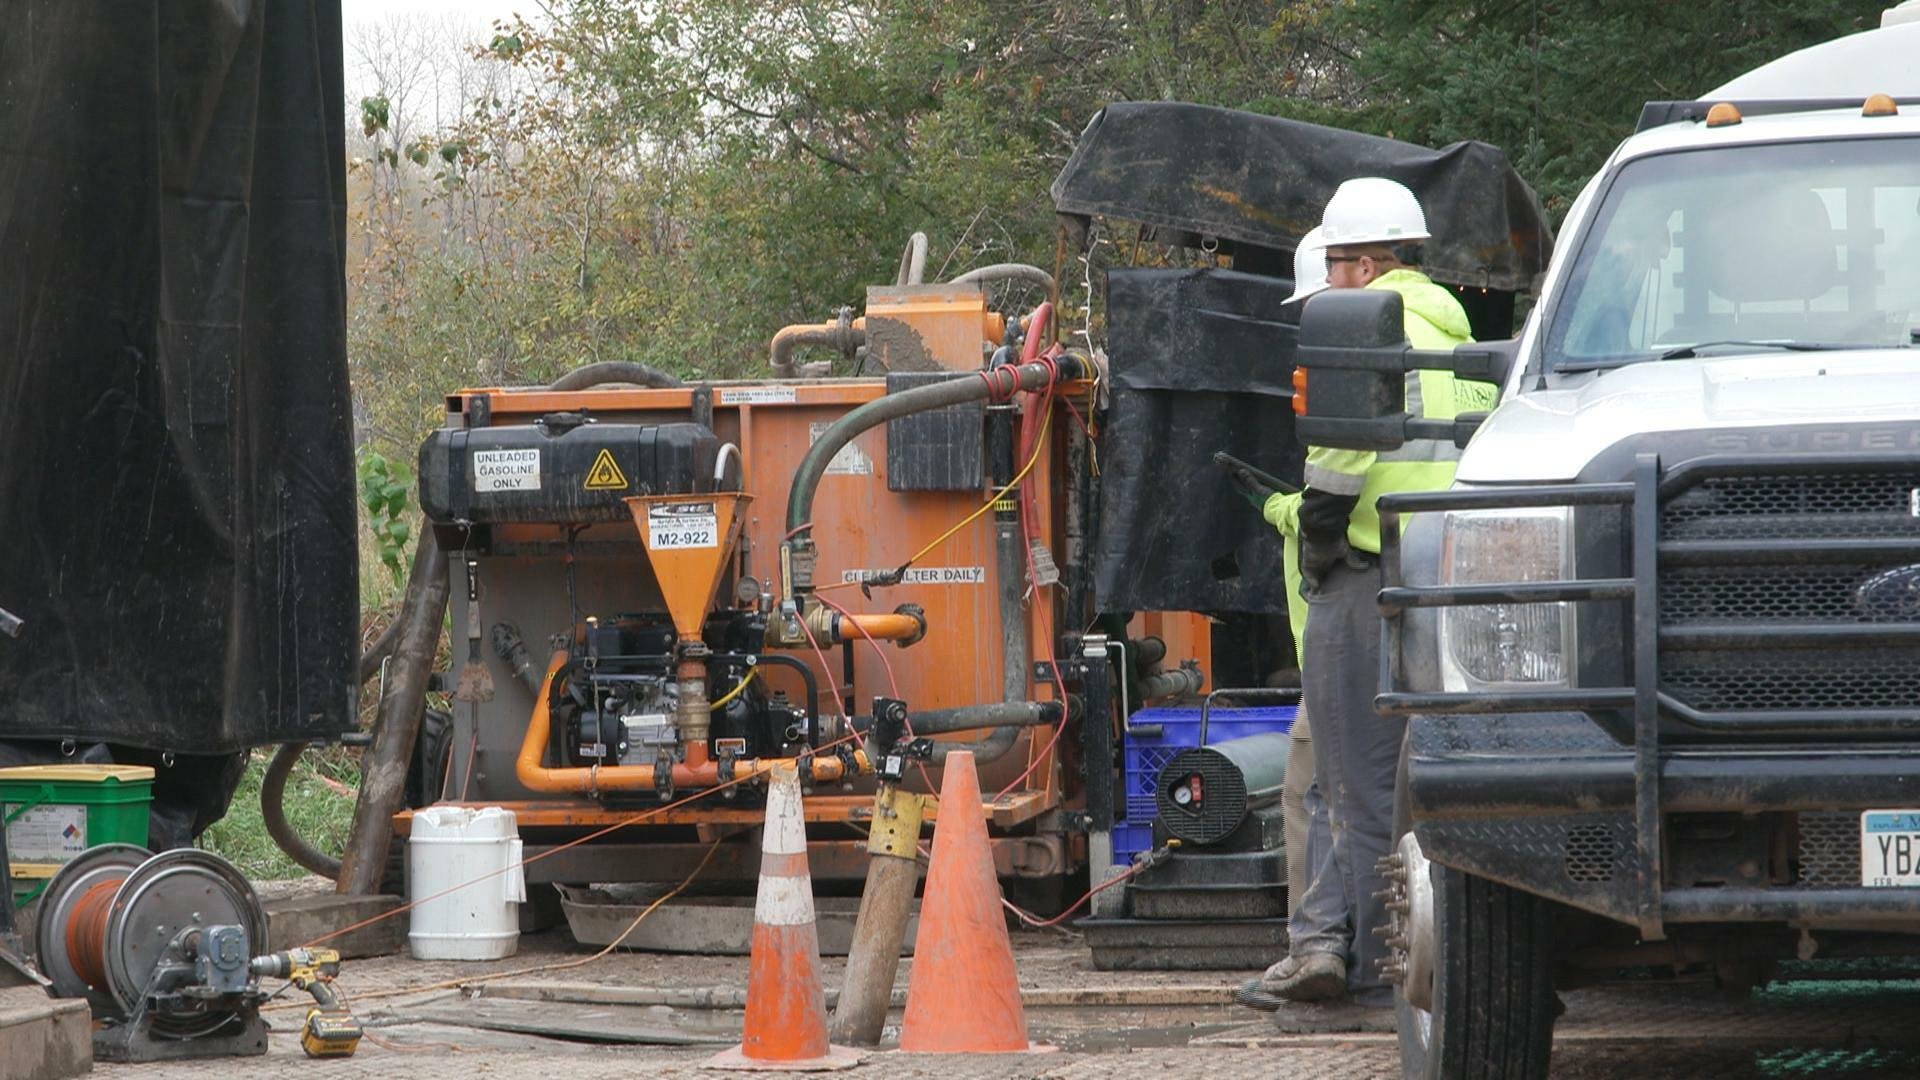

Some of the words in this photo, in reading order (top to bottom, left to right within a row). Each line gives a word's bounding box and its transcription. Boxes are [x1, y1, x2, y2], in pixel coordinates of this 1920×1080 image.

[477, 451, 536, 463] UNLEADED
[480, 464, 535, 476] GASOLINE
[493, 478, 521, 488] ONLY
[658, 531, 709, 546] M2-922
[900, 570, 938, 581] LTER
[944, 569, 981, 581] DAILY
